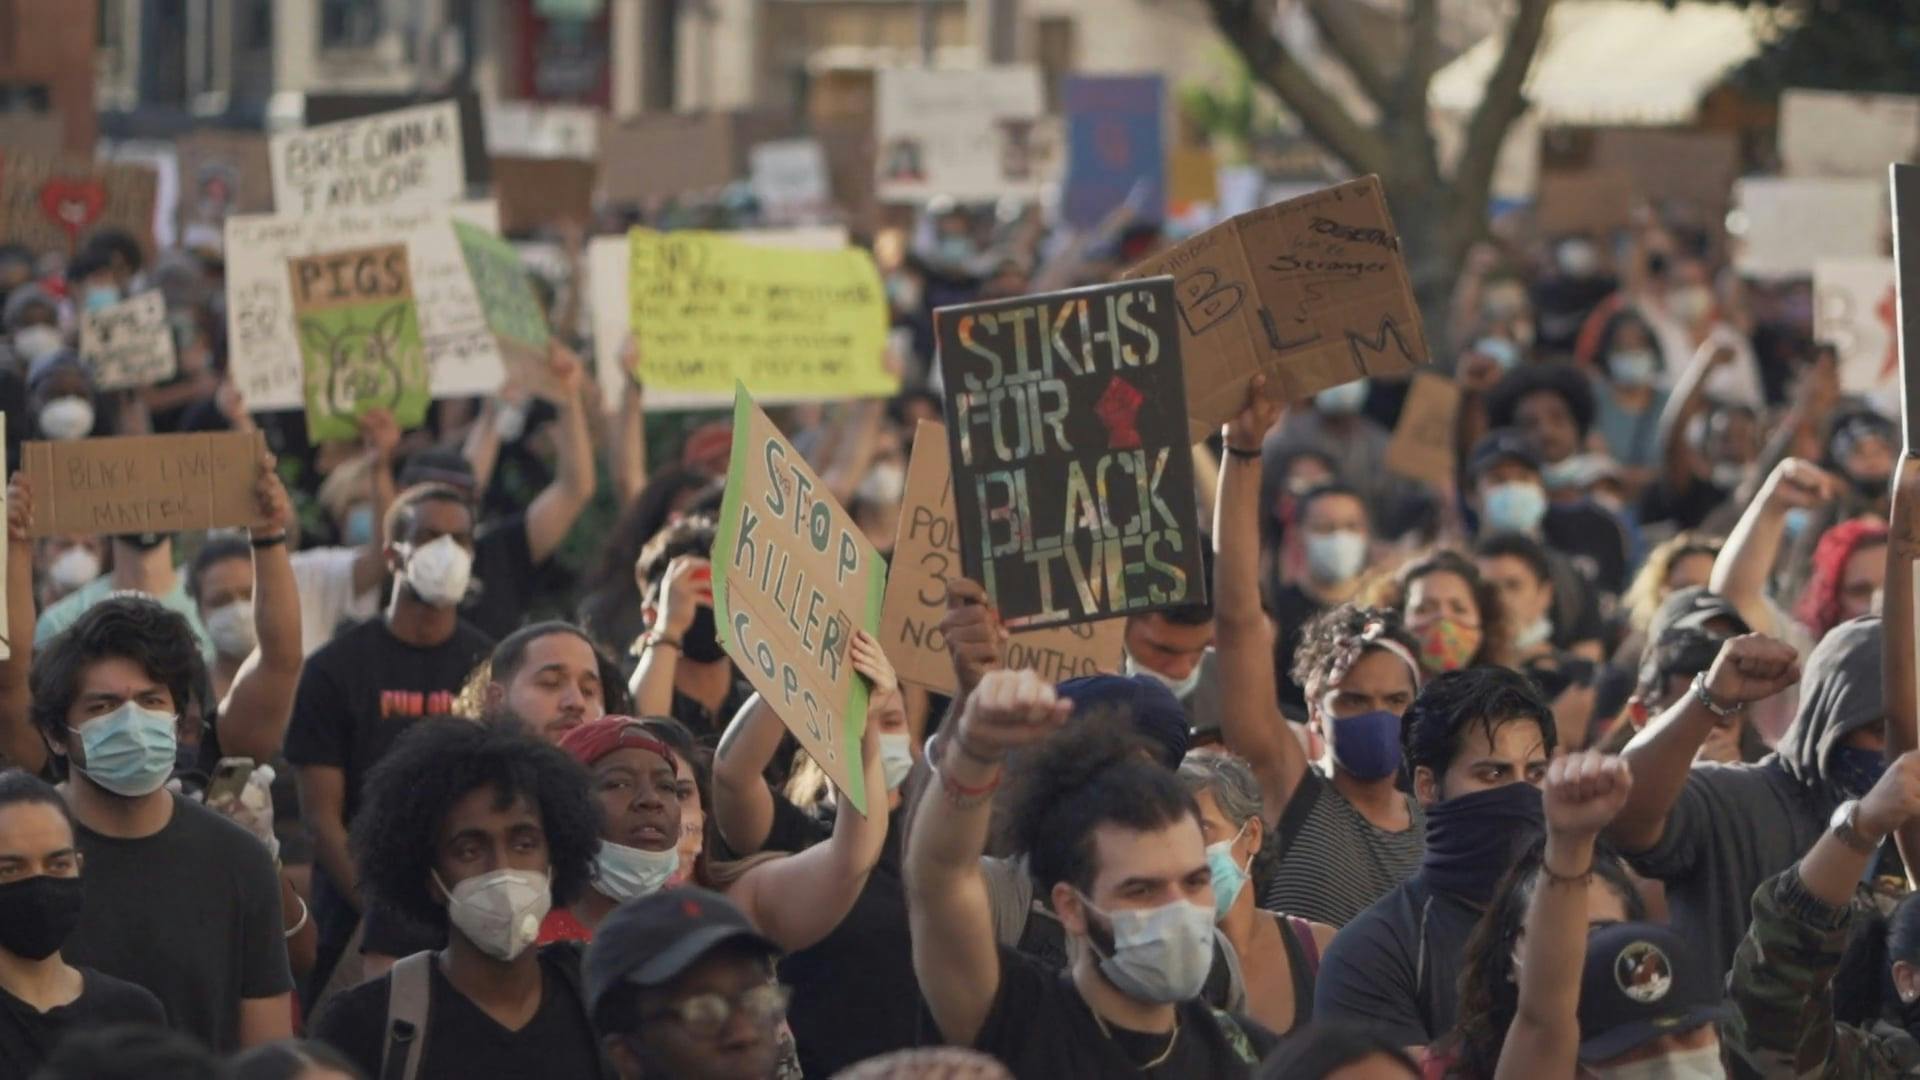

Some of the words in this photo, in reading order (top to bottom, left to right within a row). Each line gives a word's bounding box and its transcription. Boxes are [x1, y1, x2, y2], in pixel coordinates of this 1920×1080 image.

[298, 254, 405, 302] PIGS
[958, 290, 1160, 389] SIKHS
[956, 379, 1074, 467] FOR
[764, 437, 861, 586] STOP
[976, 446, 1180, 559] BLACK
[734, 503, 844, 684] KILLER
[982, 528, 1188, 628] LIVES
[734, 611, 837, 763] COPS!
[1007, 643, 1099, 683] ONTH
